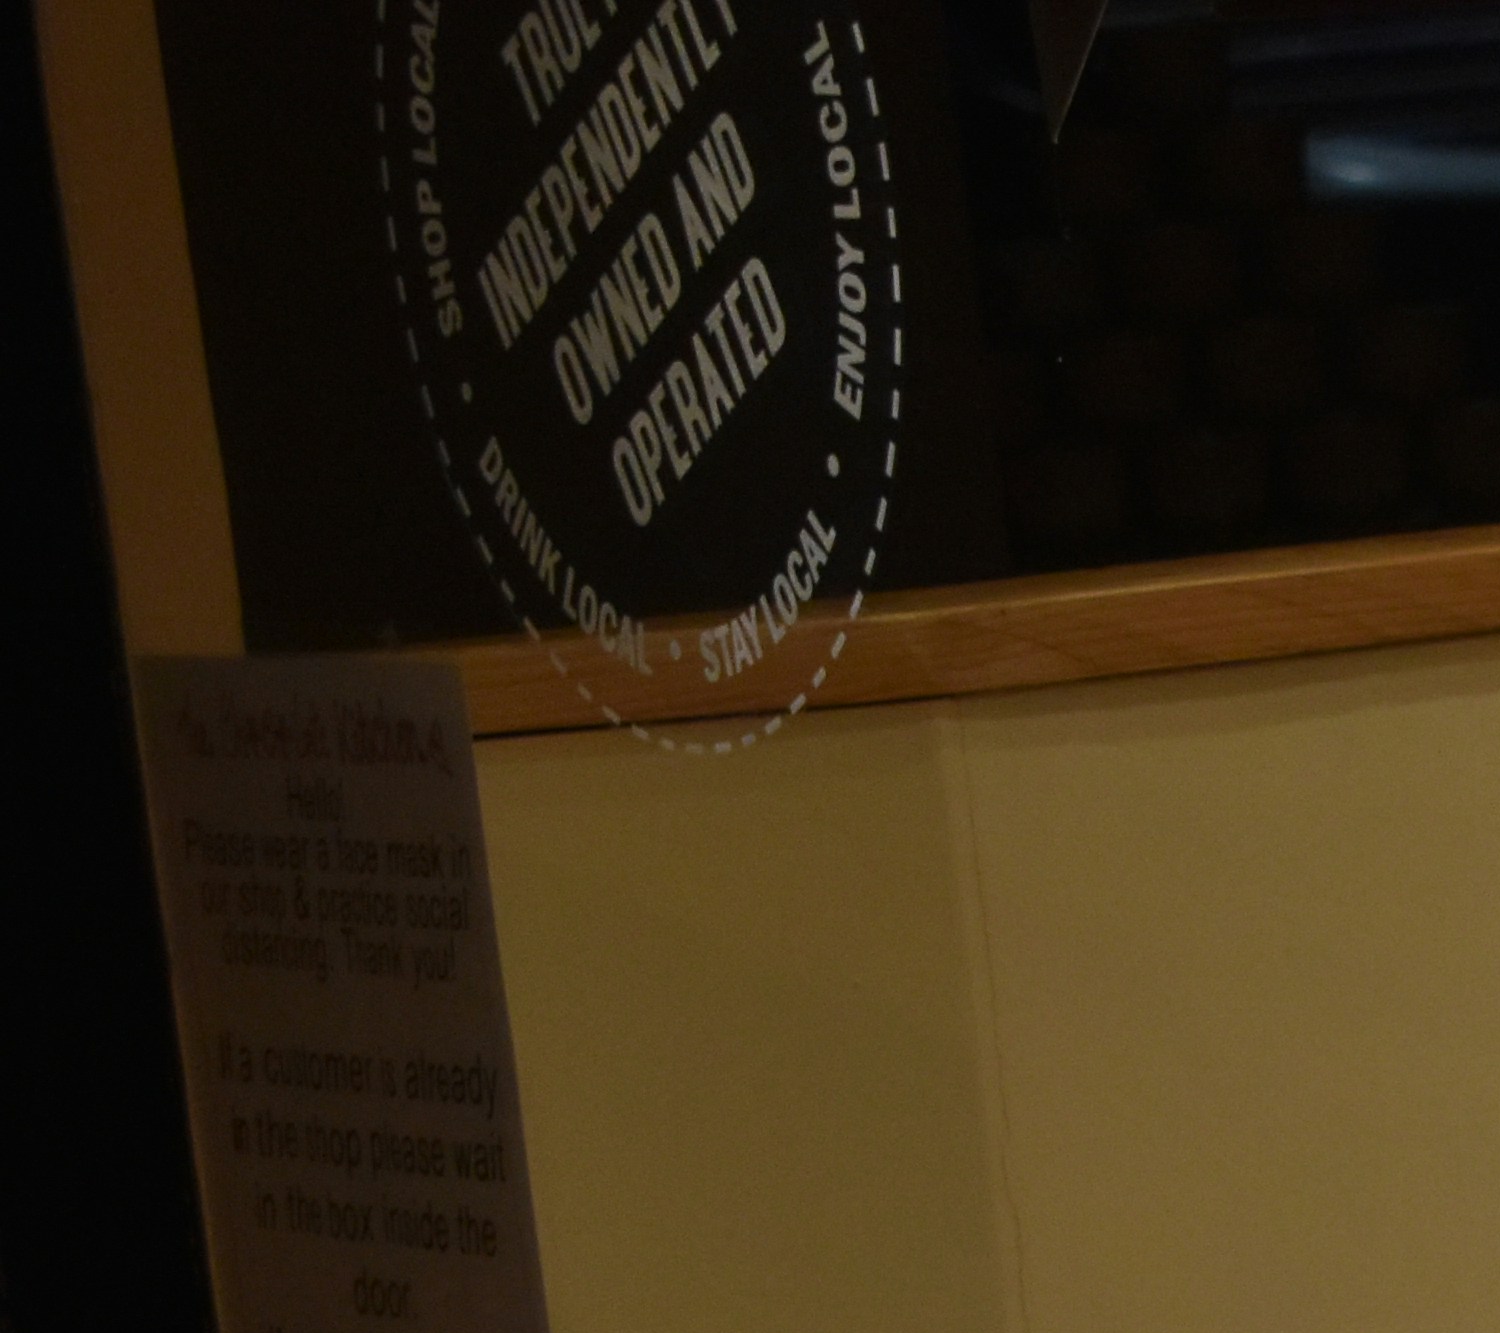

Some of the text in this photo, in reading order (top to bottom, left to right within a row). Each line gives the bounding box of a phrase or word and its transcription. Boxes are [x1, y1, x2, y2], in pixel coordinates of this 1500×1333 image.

[415, 178, 463, 337] SHOP
[554, 112, 756, 425] OWNED AND
[804, 20, 867, 421] ENJOY LOCAL
[613, 257, 786, 527] OPERATED
[480, 435, 652, 676] DRINK LOCAL
[701, 508, 836, 683] STAY LOCAL
[385, 837, 442, 876] mask
[448, 836, 471, 877] in
[404, 885, 470, 929] social
[255, 1112, 299, 1157] the
[304, 1117, 363, 1175] shop
[368, 1126, 446, 1180] please
[451, 1129, 506, 1182] wait
[263, 1048, 375, 1092] customer
[401, 1051, 502, 1118] already
[285, 1188, 322, 1233] the
[326, 1195, 375, 1241] box
[380, 1197, 450, 1251] inside
[456, 1207, 497, 1255] the
